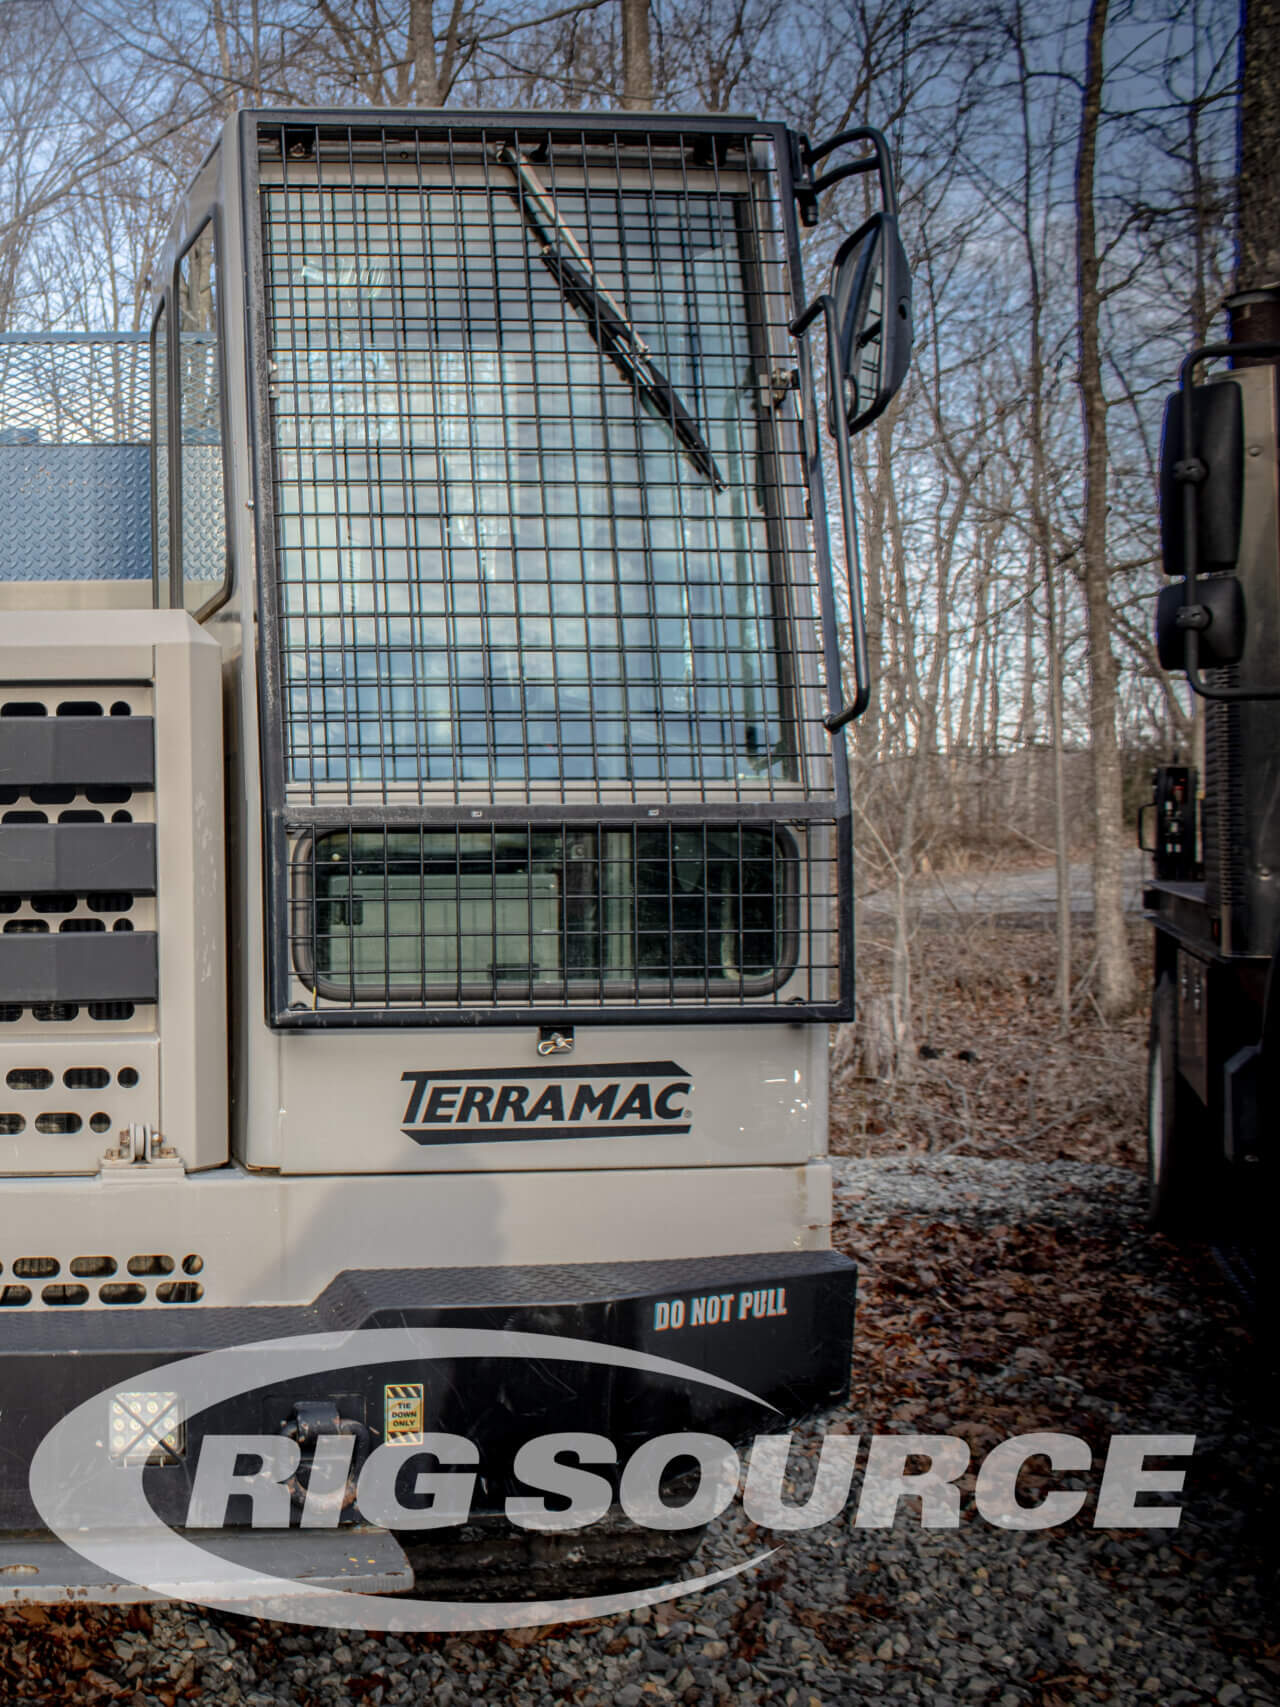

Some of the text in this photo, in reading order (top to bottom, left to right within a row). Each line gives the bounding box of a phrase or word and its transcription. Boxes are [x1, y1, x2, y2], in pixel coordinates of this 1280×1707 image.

[400, 1071, 693, 1124] TERRAMAC
[654, 1287, 788, 1331] DO NOT PULL
[392, 1419, 416, 1427] ONLY
